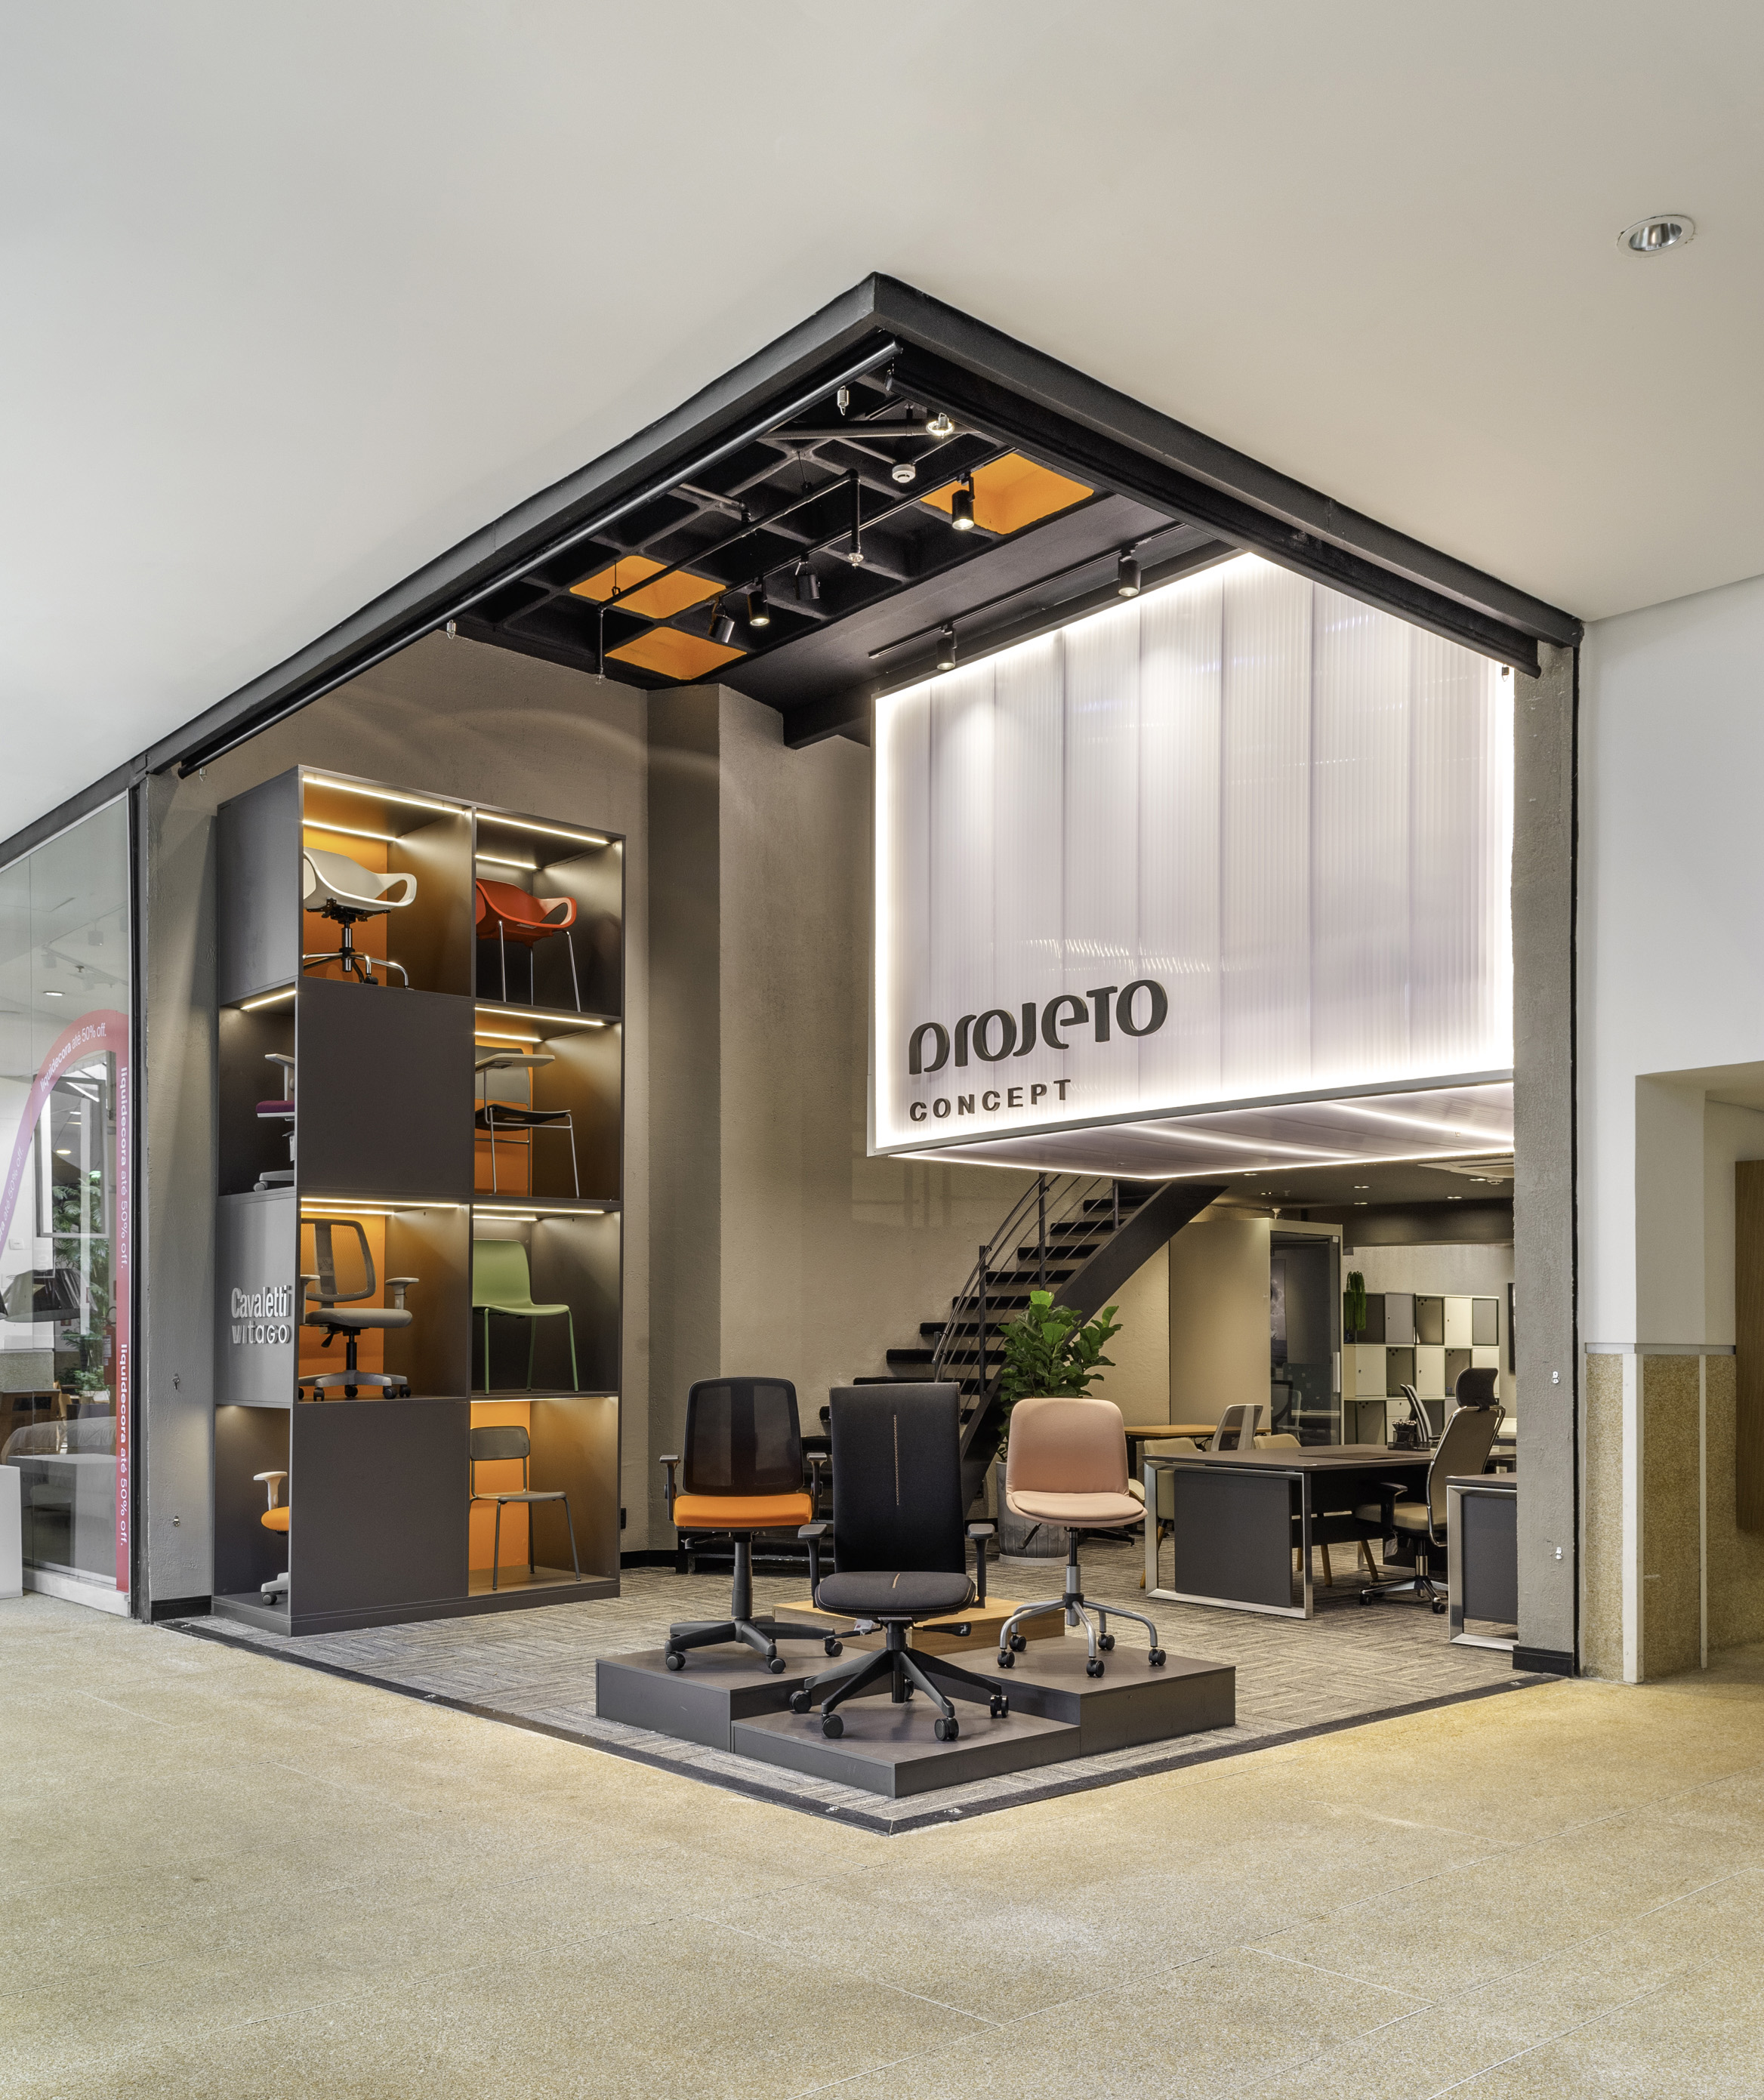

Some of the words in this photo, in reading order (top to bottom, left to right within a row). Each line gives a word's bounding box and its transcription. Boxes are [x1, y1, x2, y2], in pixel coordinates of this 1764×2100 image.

[40, 1042, 72, 1092] liquidecora
[72, 1031, 82, 1050] até
[82, 1024, 96, 1042] 50%
[96, 1022, 107, 1038] off.
[119, 1067, 128, 1167] liquidecora
[909, 1078, 1071, 1122] CONCEPT
[231, 1284, 291, 1318] Cavaletti
[119, 1343, 128, 1444] liquidecora
